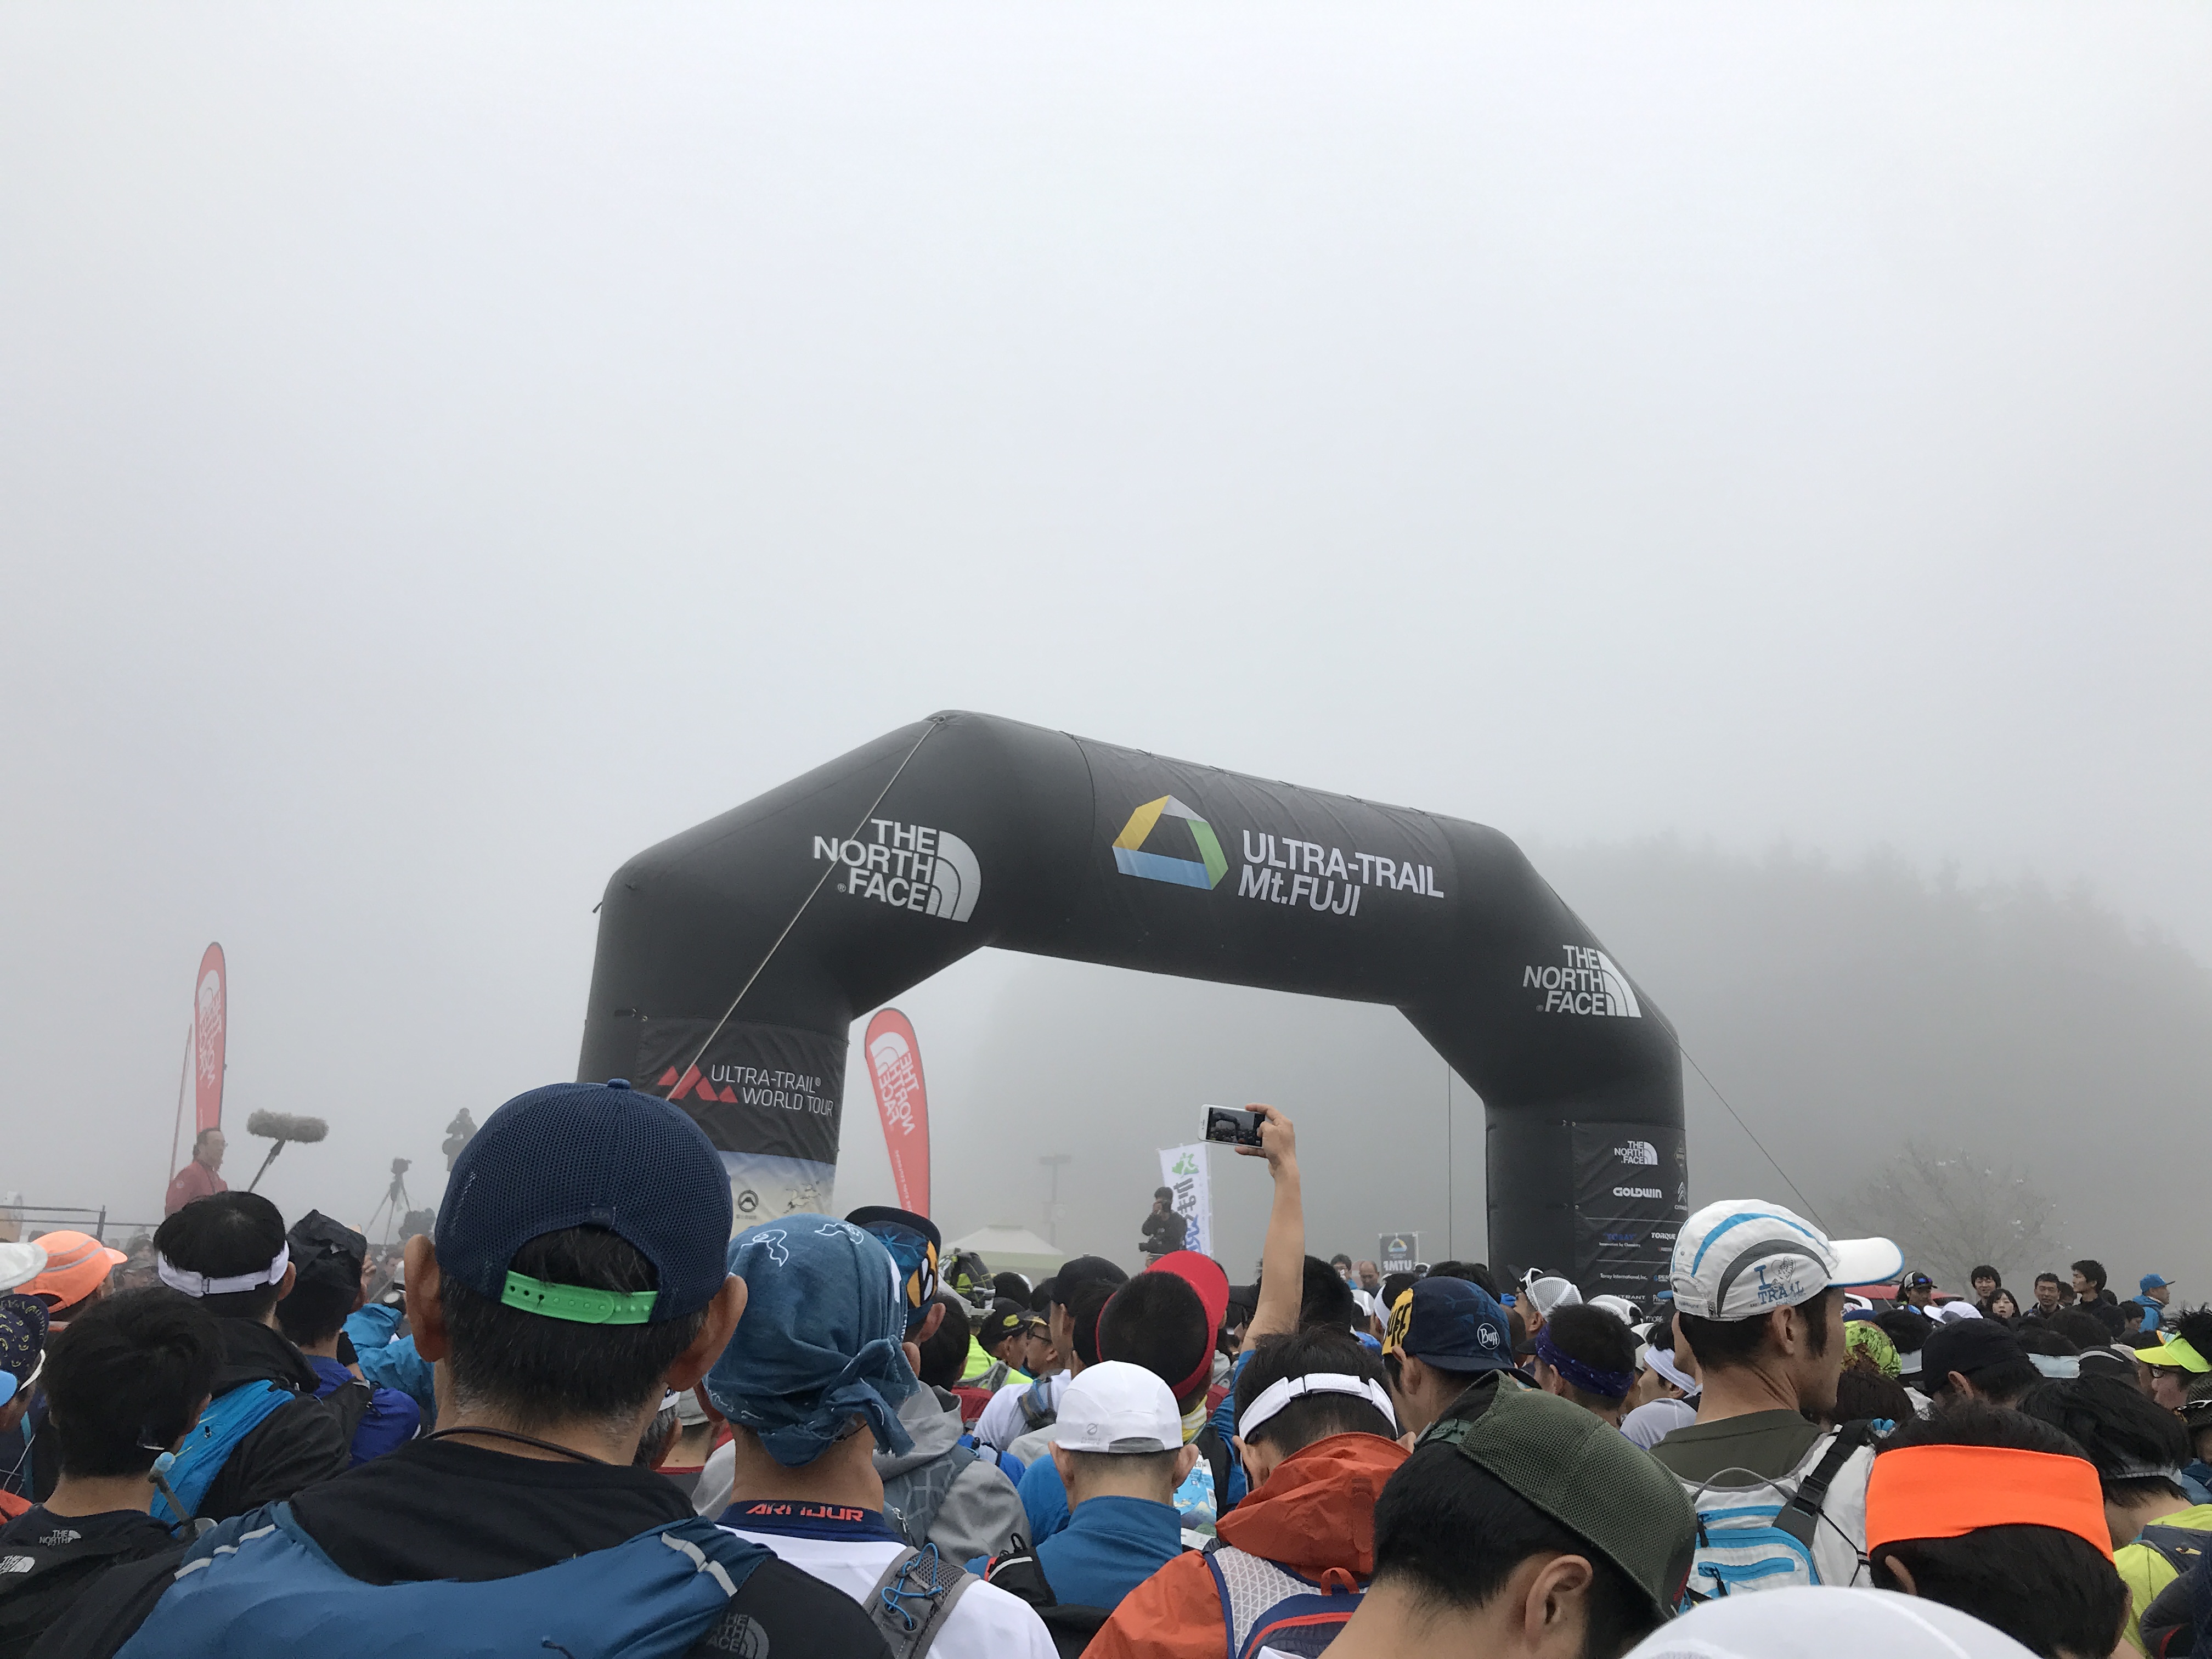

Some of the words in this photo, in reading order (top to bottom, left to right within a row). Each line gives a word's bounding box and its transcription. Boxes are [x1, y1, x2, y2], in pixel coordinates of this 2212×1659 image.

[871, 818, 937, 855] THE
[813, 835, 934, 884] NORTH
[1243, 829, 1444, 899] ULTRA-TRAIL
[848, 867, 929, 912] FACE
[1238, 865, 1361, 917] Mt.FUJI
[1562, 944, 1600, 970] THE
[1522, 965, 1604, 992] NORTH
[1545, 990, 1605, 1016] FACE
[742, 1087, 803, 1111] WORLD
[806, 1095, 834, 1117] TOUR
[1614, 1148, 1644, 1156] NORTH
[1627, 1140, 1644, 1149] THE
[1623, 1156, 1644, 1165] FACE
[1612, 1187, 1662, 1199] GOLDWIN
[39, 1536, 69, 1544] NORTH
